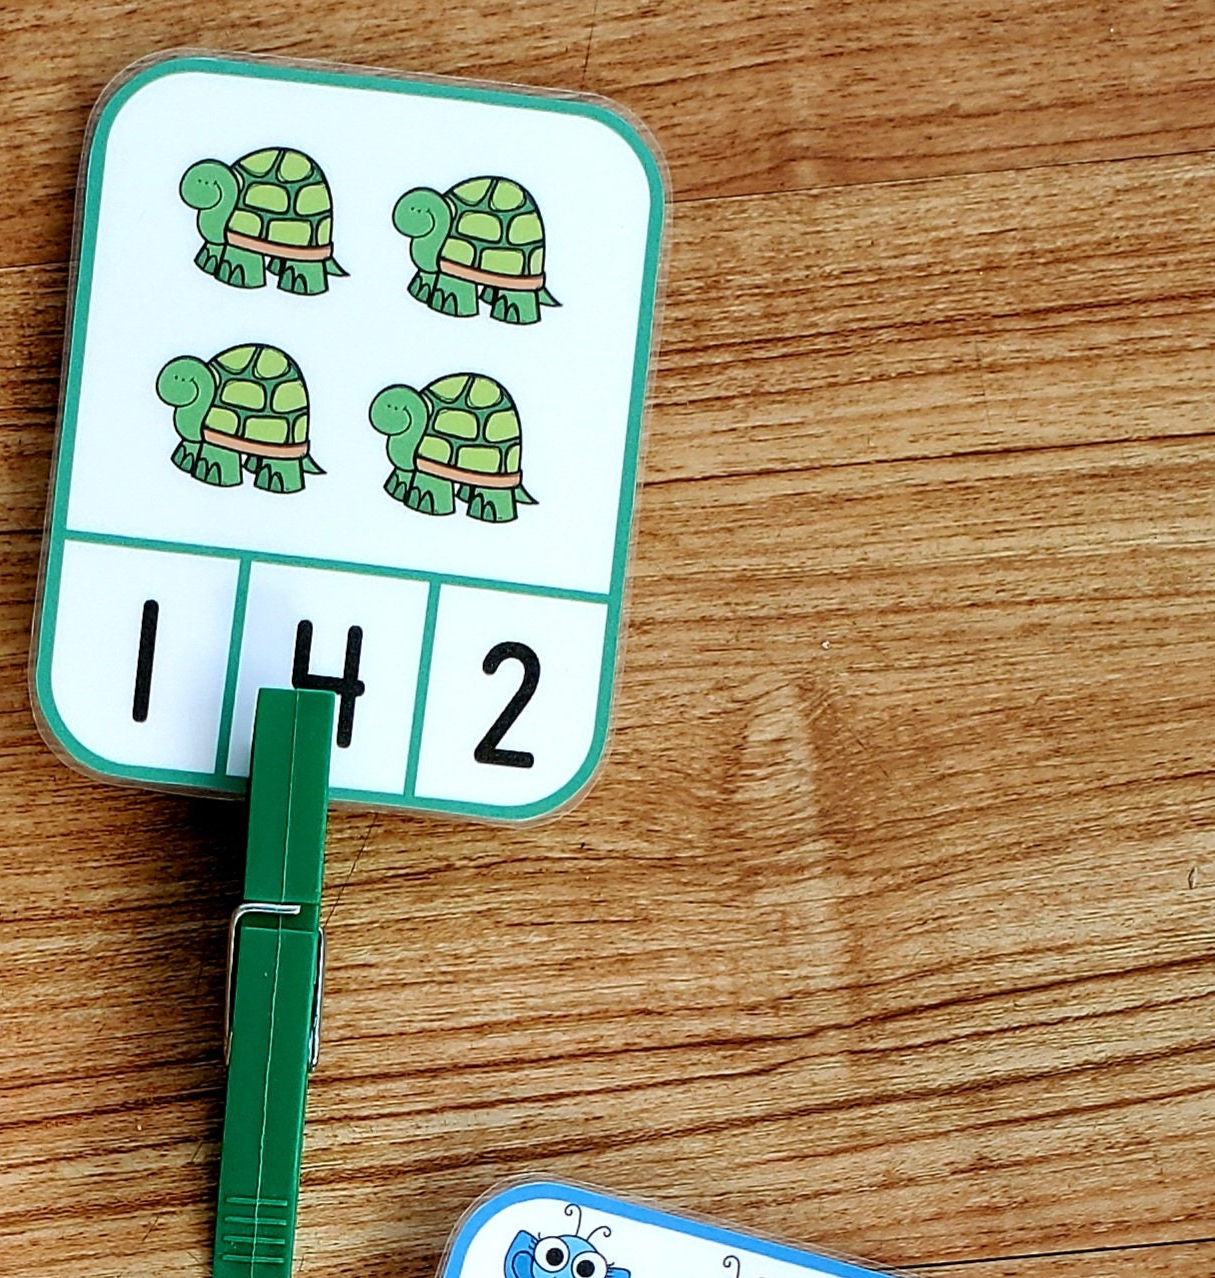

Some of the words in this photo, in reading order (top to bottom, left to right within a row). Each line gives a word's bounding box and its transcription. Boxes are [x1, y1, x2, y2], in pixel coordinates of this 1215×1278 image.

[132, 599, 159, 723] 1
[291, 619, 366, 749] 4
[473, 641, 541, 769] 2
